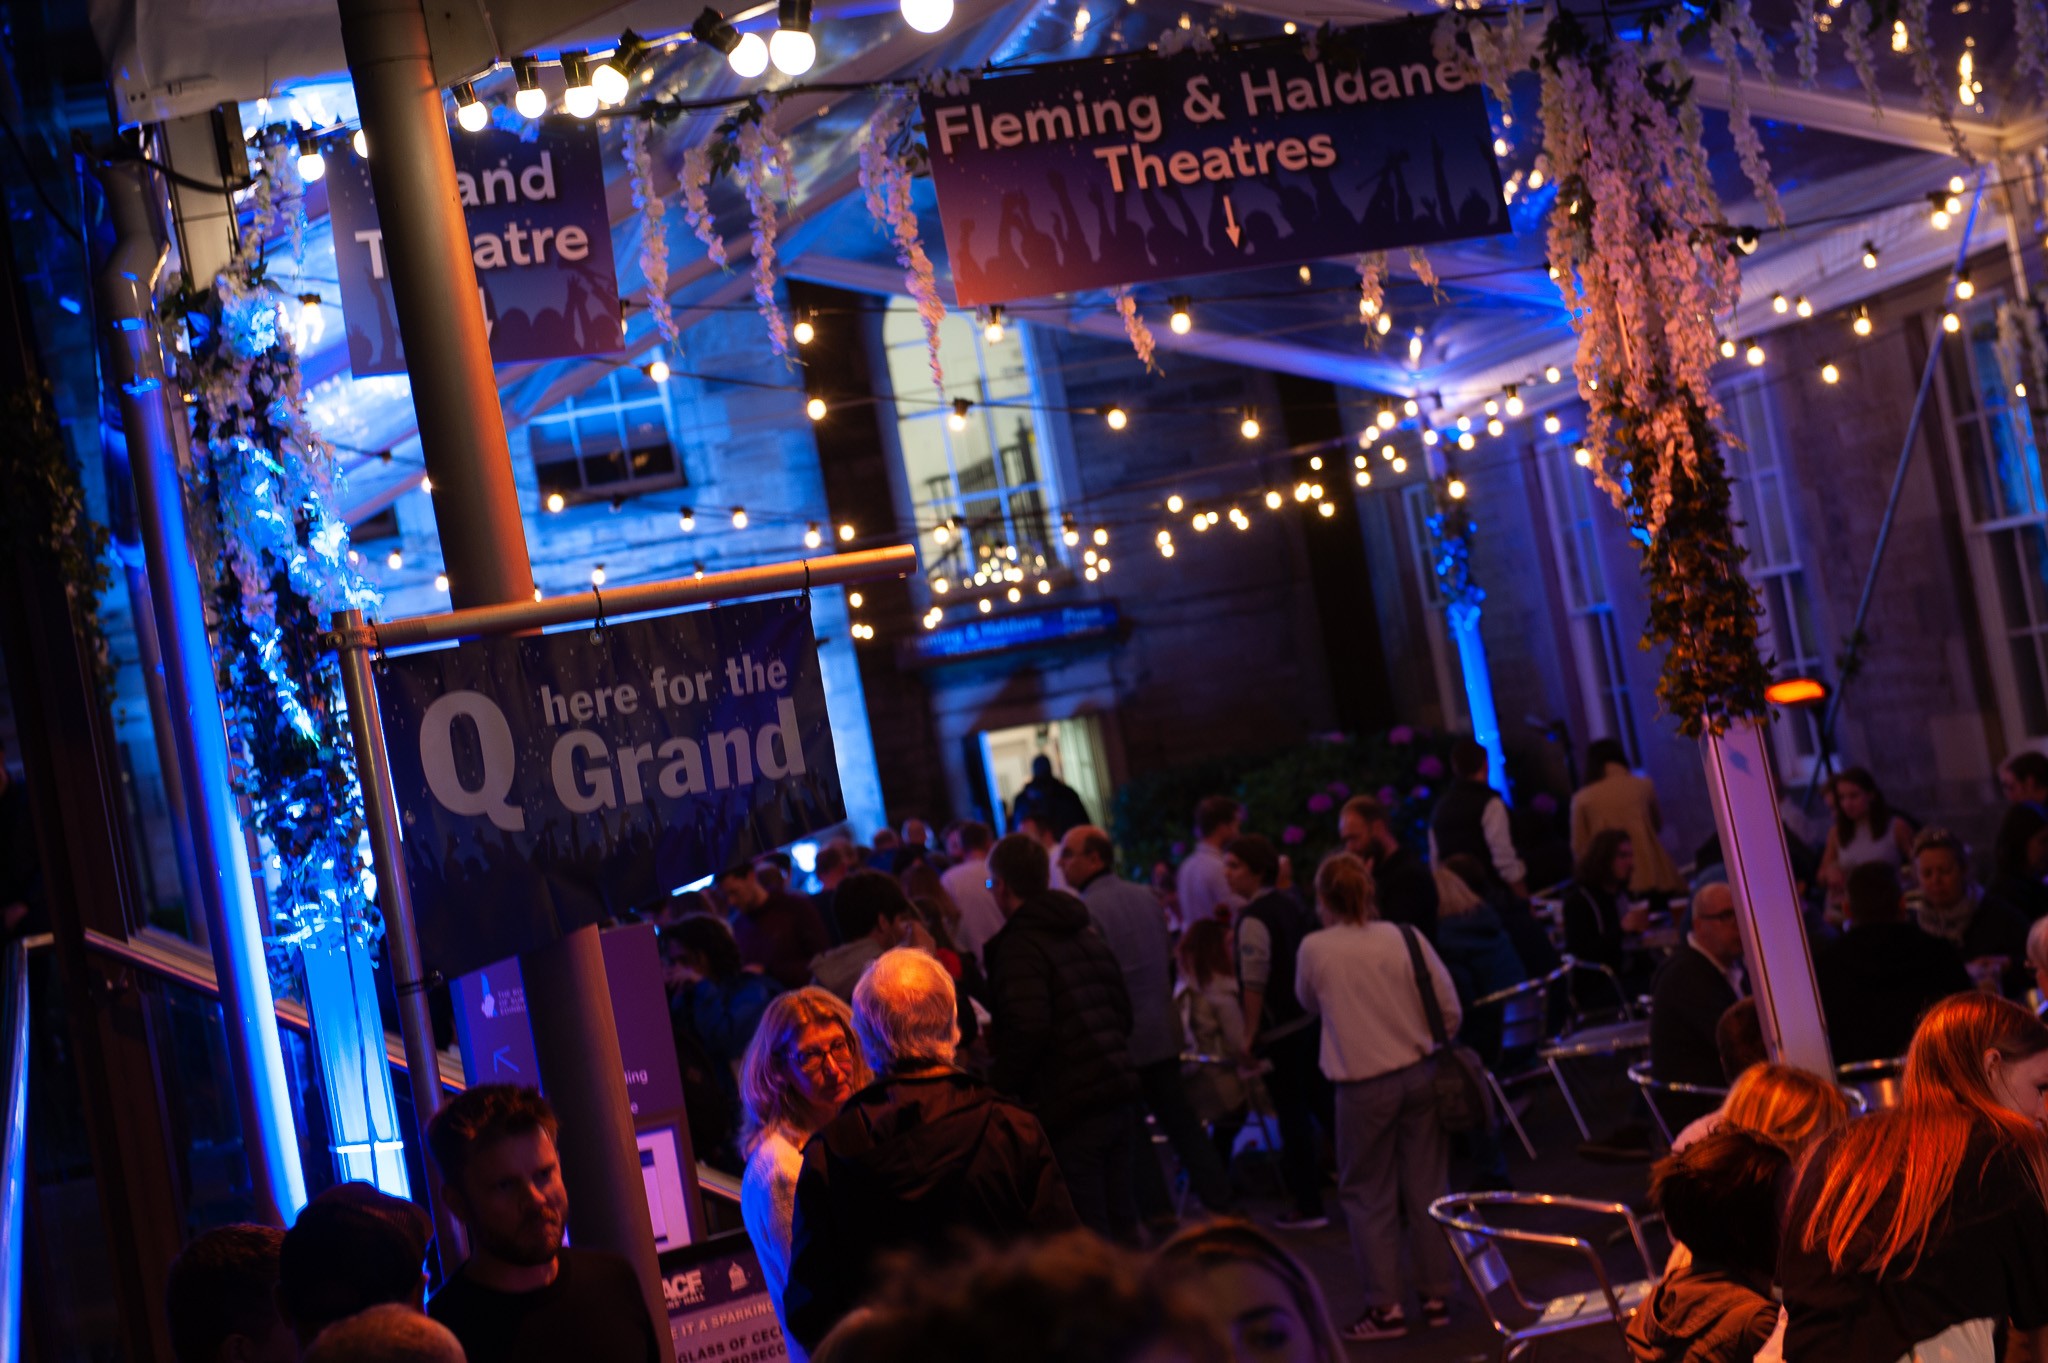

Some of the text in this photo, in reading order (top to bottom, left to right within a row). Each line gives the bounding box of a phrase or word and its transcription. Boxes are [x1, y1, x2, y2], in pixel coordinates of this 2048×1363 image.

[935, 60, 1466, 154] Fleming & Haldane
[1095, 132, 1337, 192] Theatres
[355, 222, 589, 279] Tatre
[541, 654, 788, 727] here for the
[420, 689, 526, 832] Q
[551, 697, 806, 814] Grand
[678, 1344, 725, 1363] GLASS
[729, 1335, 747, 1351] OF
[682, 1321, 694, 1337] IT
[699, 1319, 708, 1332] A
